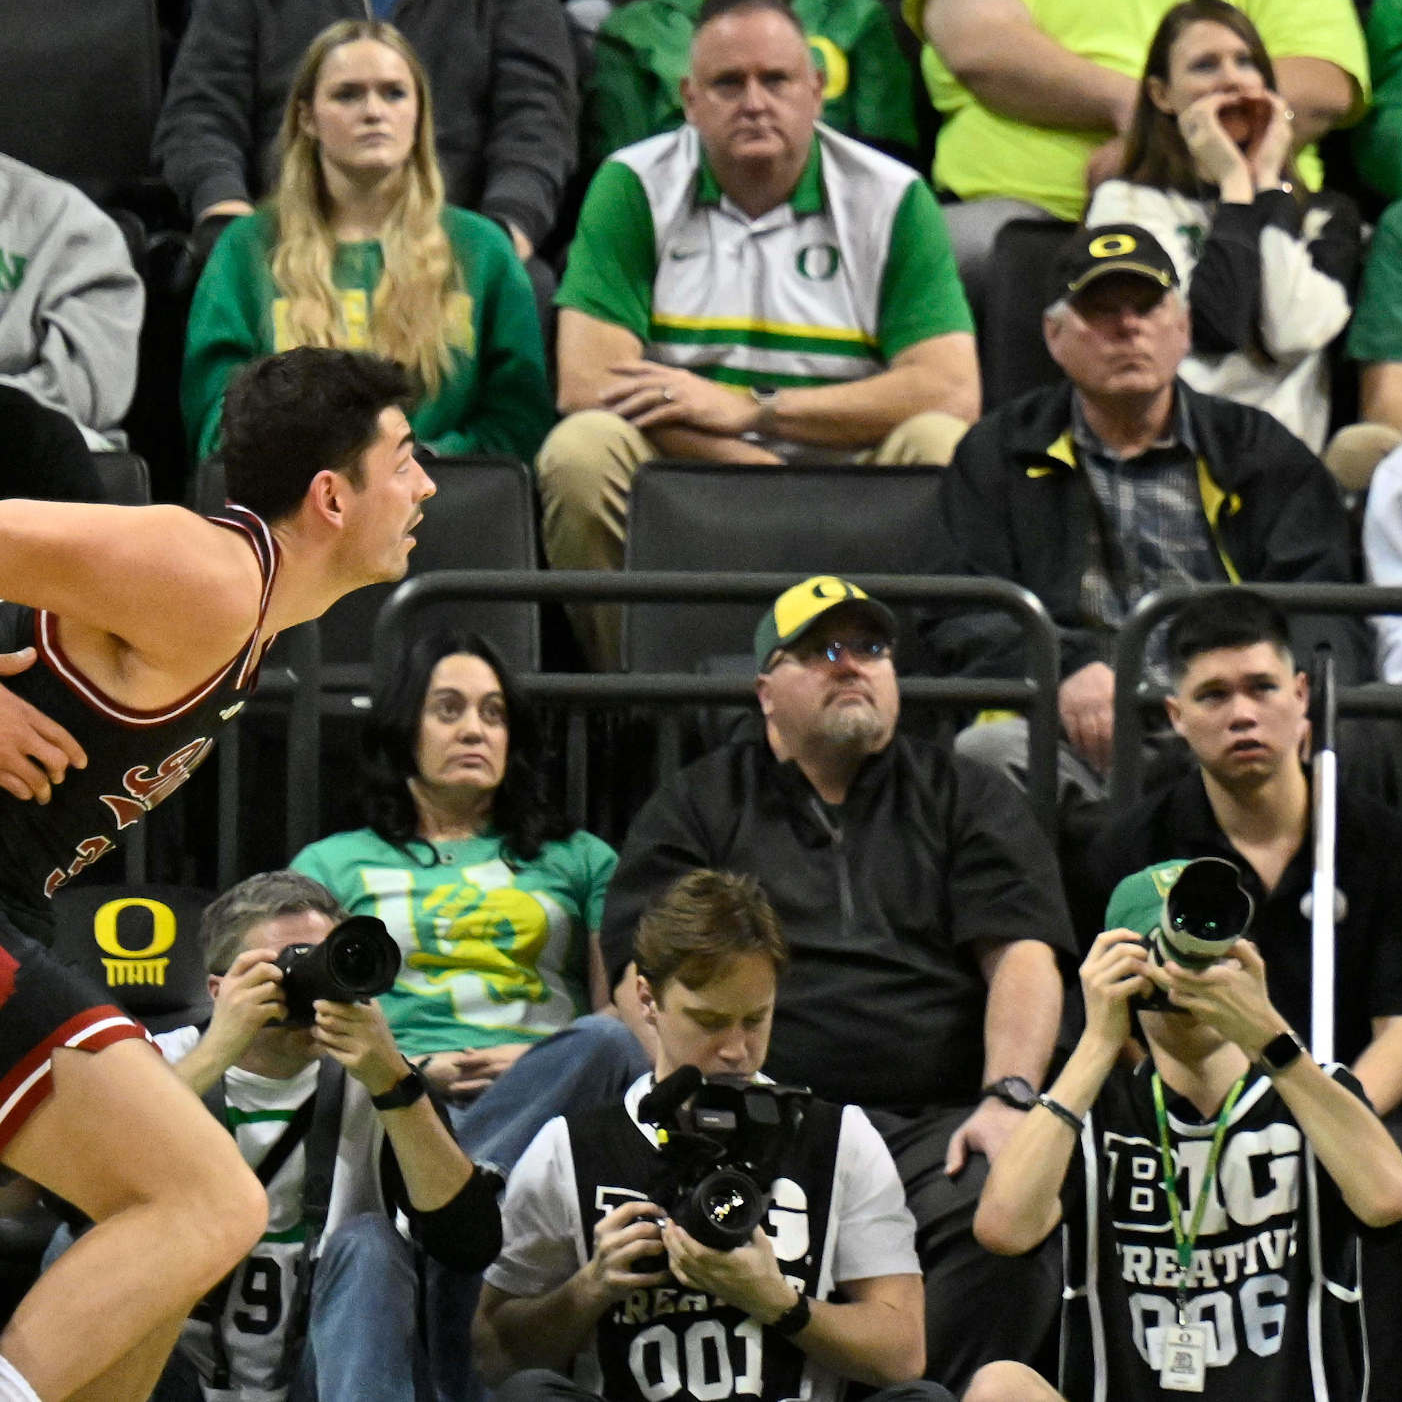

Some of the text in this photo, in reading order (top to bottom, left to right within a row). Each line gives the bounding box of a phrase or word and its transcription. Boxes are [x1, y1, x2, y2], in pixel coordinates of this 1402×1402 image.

[1089, 234, 1137, 258] O
[93, 897, 177, 959] O
[1115, 1218, 1298, 1289] REATIV
[628, 1318, 765, 1402] 001
